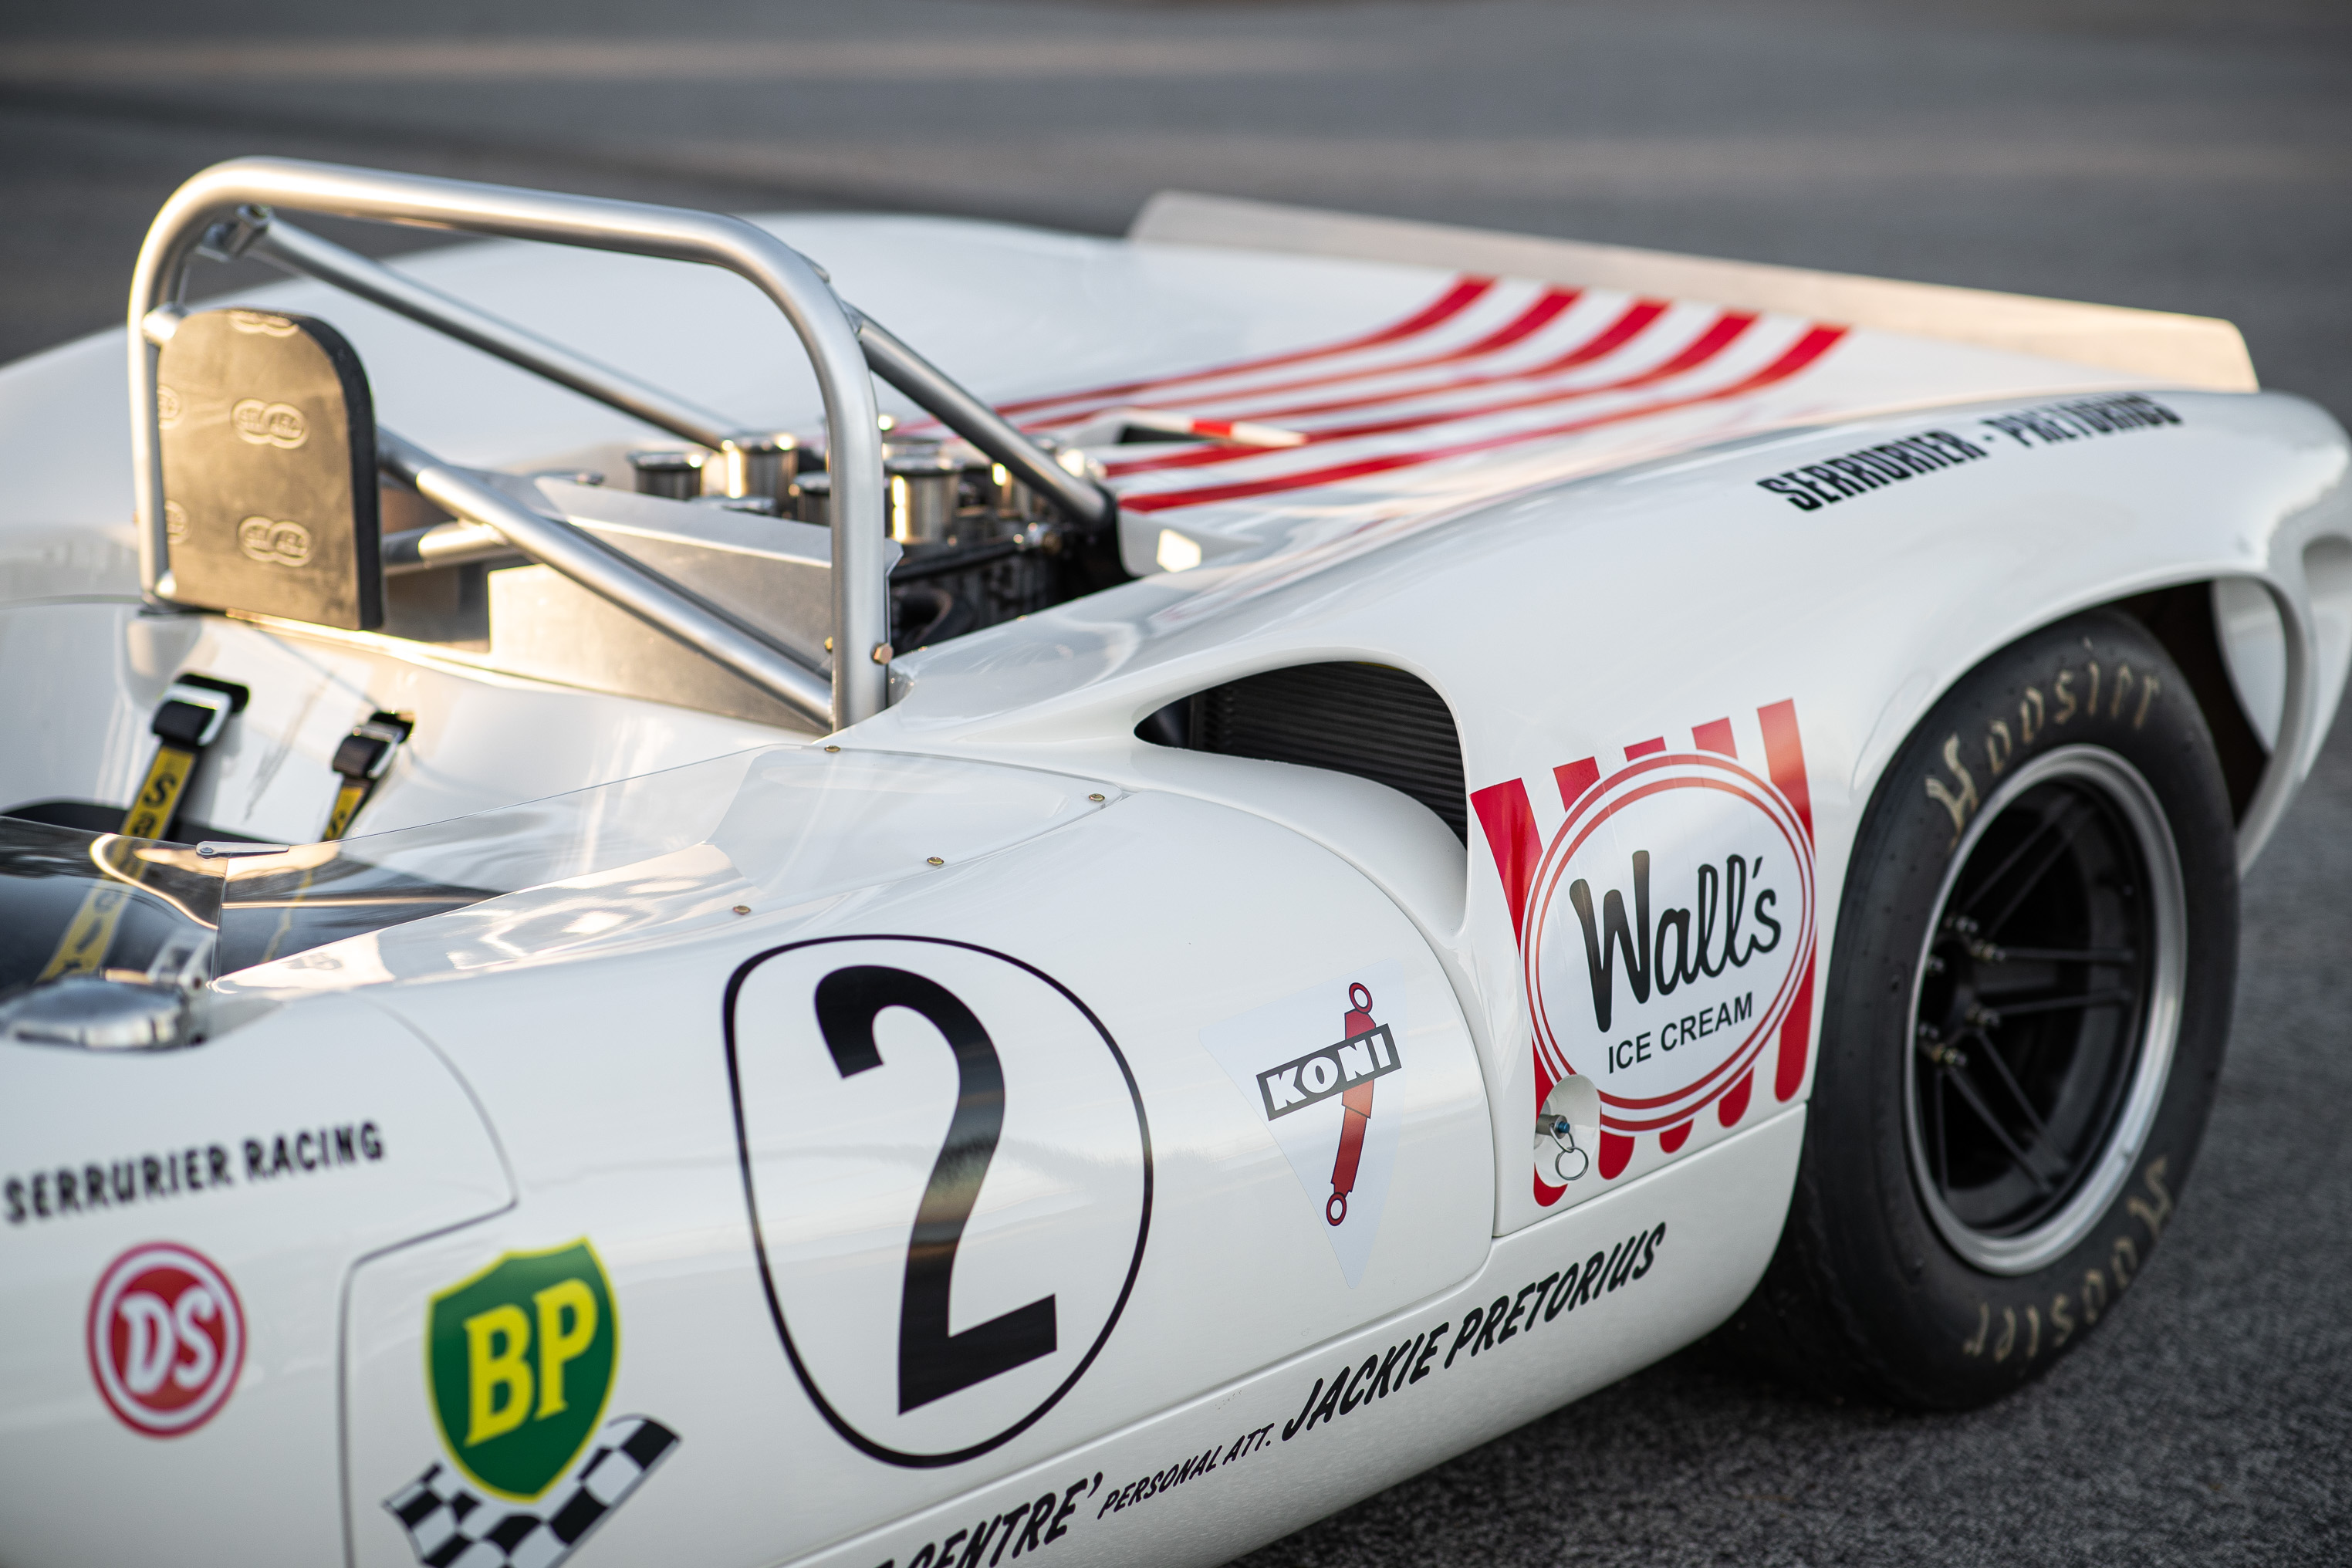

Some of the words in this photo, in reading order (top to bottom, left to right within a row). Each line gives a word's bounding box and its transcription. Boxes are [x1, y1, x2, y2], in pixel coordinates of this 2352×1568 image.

[1756, 428, 1990, 512] SERRURIER
[1569, 850, 1782, 1032] Wall's
[1266, 1032, 1391, 1111] KONI
[1608, 1031, 1651, 1075] ICE
[1661, 992, 1754, 1052] CREAM
[4, 1144, 234, 1224] SERRURIER
[243, 1118, 384, 1180] RACING
[814, 965, 1057, 1416] 2
[120, 1286, 214, 1394] DS
[463, 1278, 599, 1448] BP
[1097, 1445, 1222, 1520] PERSONAL
[1222, 1423, 1275, 1466] ATT.
[1282, 1322, 1449, 1441] JACKIE
[1444, 1222, 1666, 1369] PRETORIUS
